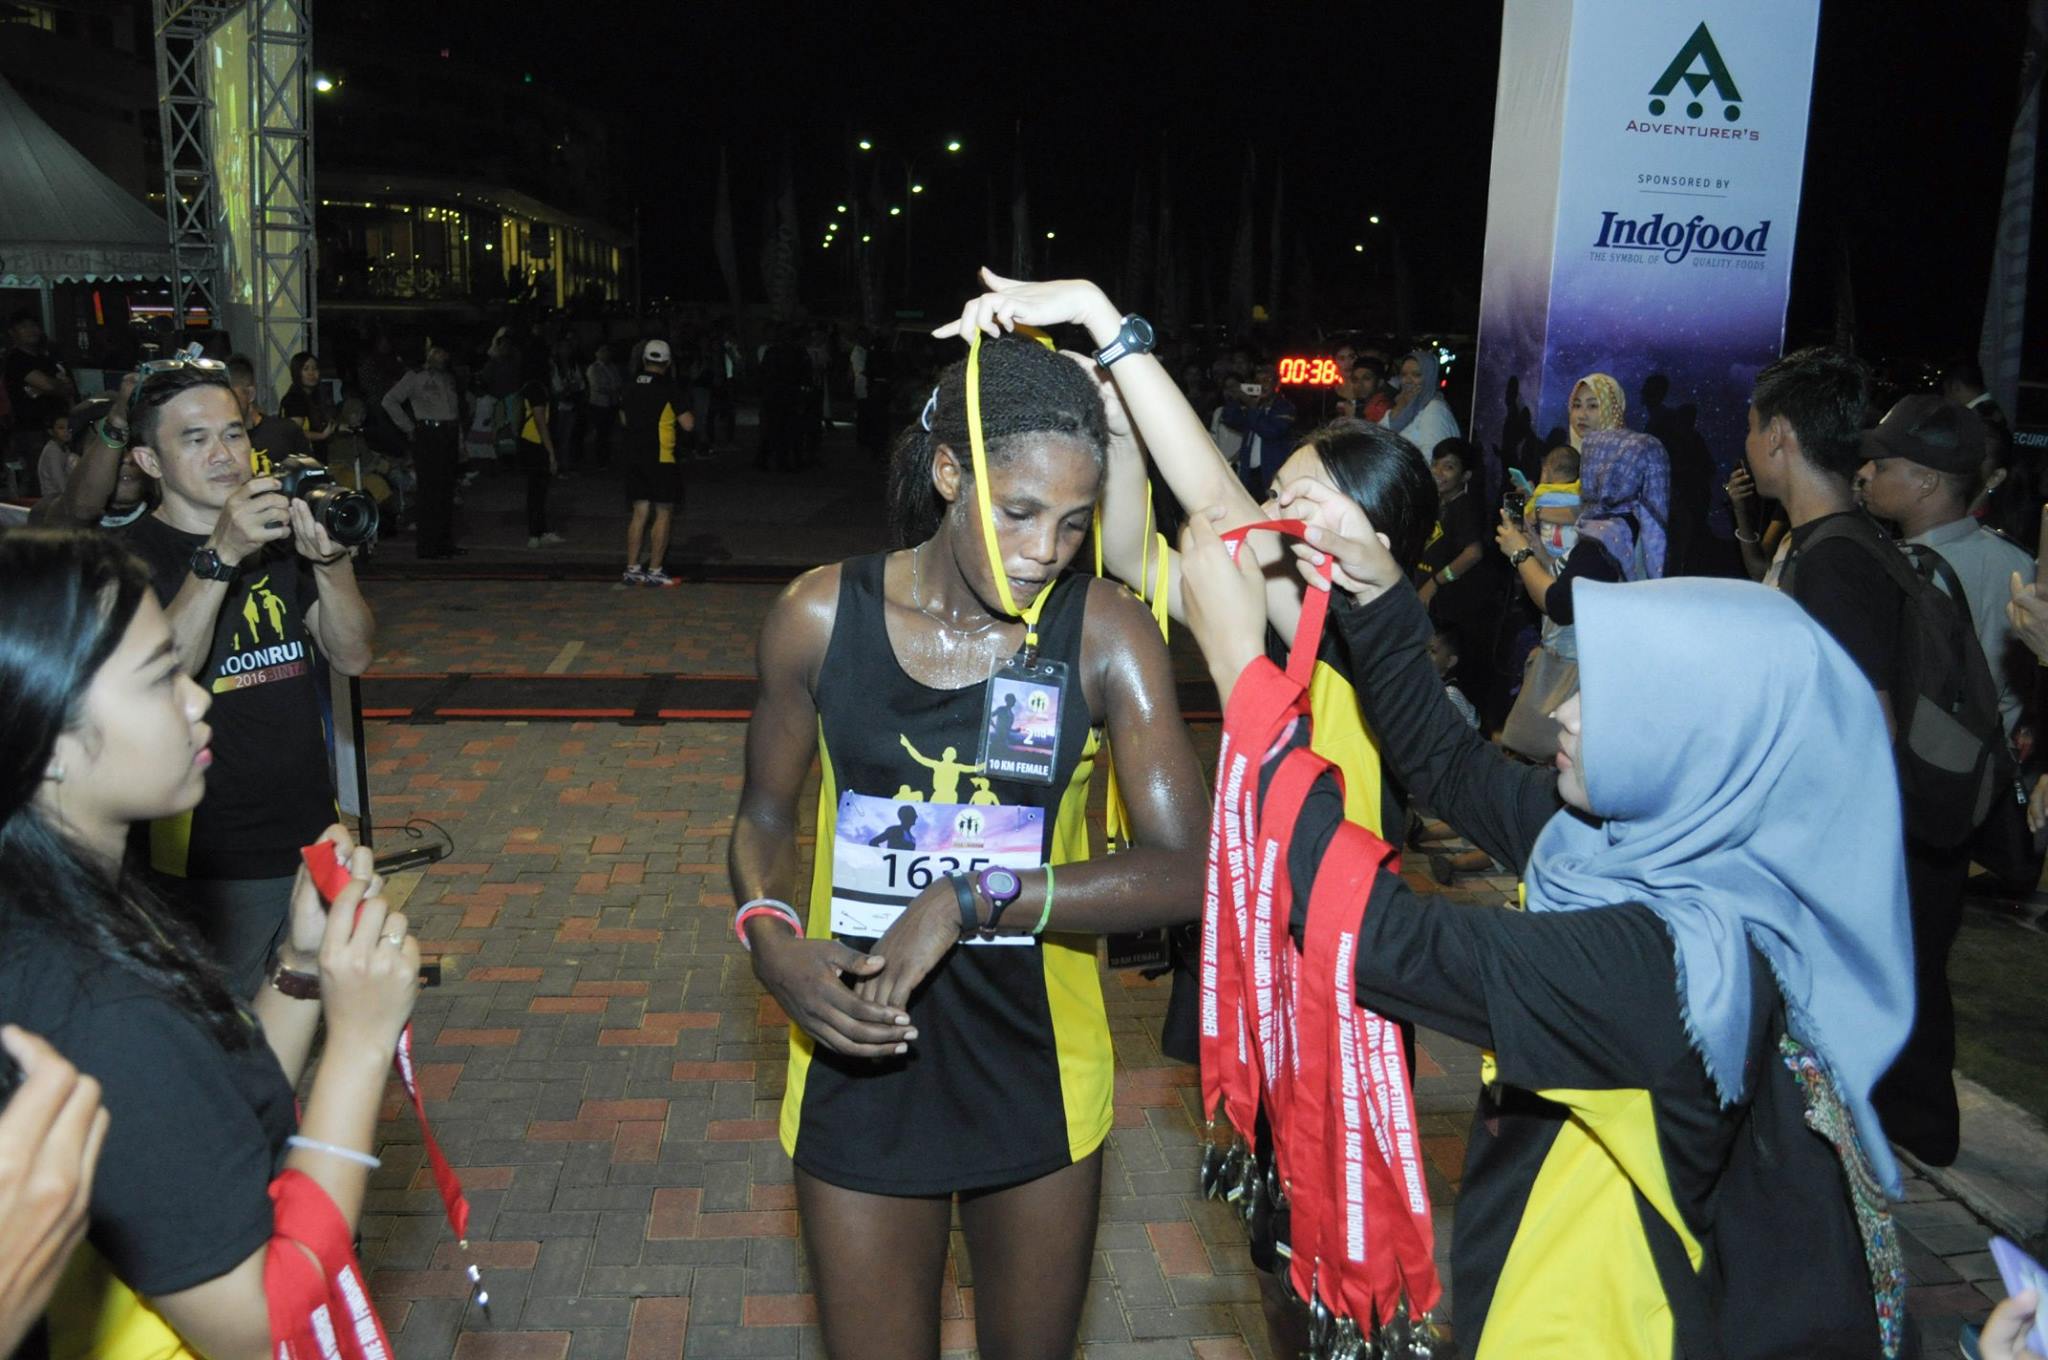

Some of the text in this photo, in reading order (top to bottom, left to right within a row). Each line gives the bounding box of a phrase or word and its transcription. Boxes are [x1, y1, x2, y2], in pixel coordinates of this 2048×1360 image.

[1626, 120, 1760, 141] ADVENTURER'S
[1637, 174, 1730, 189] SPONSORED BY
[1593, 211, 1771, 264] Indofood
[1590, 252, 1766, 271] THE SYMBOL OF QUALITY FOODS
[1280, 358, 1343, 384] 00:38
[234, 671, 267, 688] 2016
[990, 759, 1049, 776] 10 KM FEMALE
[1224, 752, 1248, 814] MOONRUN
[1227, 848, 1244, 878] 2016
[1258, 838, 1279, 895] FINISHER
[1256, 891, 1273, 921] RUN
[1204, 894, 1219, 966] COMPETITIVE
[1254, 919, 1272, 988] COMPETITIVE
[1203, 964, 1217, 990] RUN
[1202, 988, 1218, 1037] FINISHER
[1256, 987, 1272, 1017] 10KM
[1365, 1018, 1381, 1050] 2016
[1369, 1047, 1386, 1084] 10KM
[1335, 931, 1365, 1263] MOONRUN BINTAN 2016 10KM COMPETITIVE RUN FINISHER
[1384, 1054, 1411, 1131] COMPETITIVE
[1396, 1131, 1415, 1160] RUN
[1401, 1159, 1425, 1214] FINISHER
[337, 1264, 371, 1322] FINISHER
[355, 1313, 379, 1346] RUN
